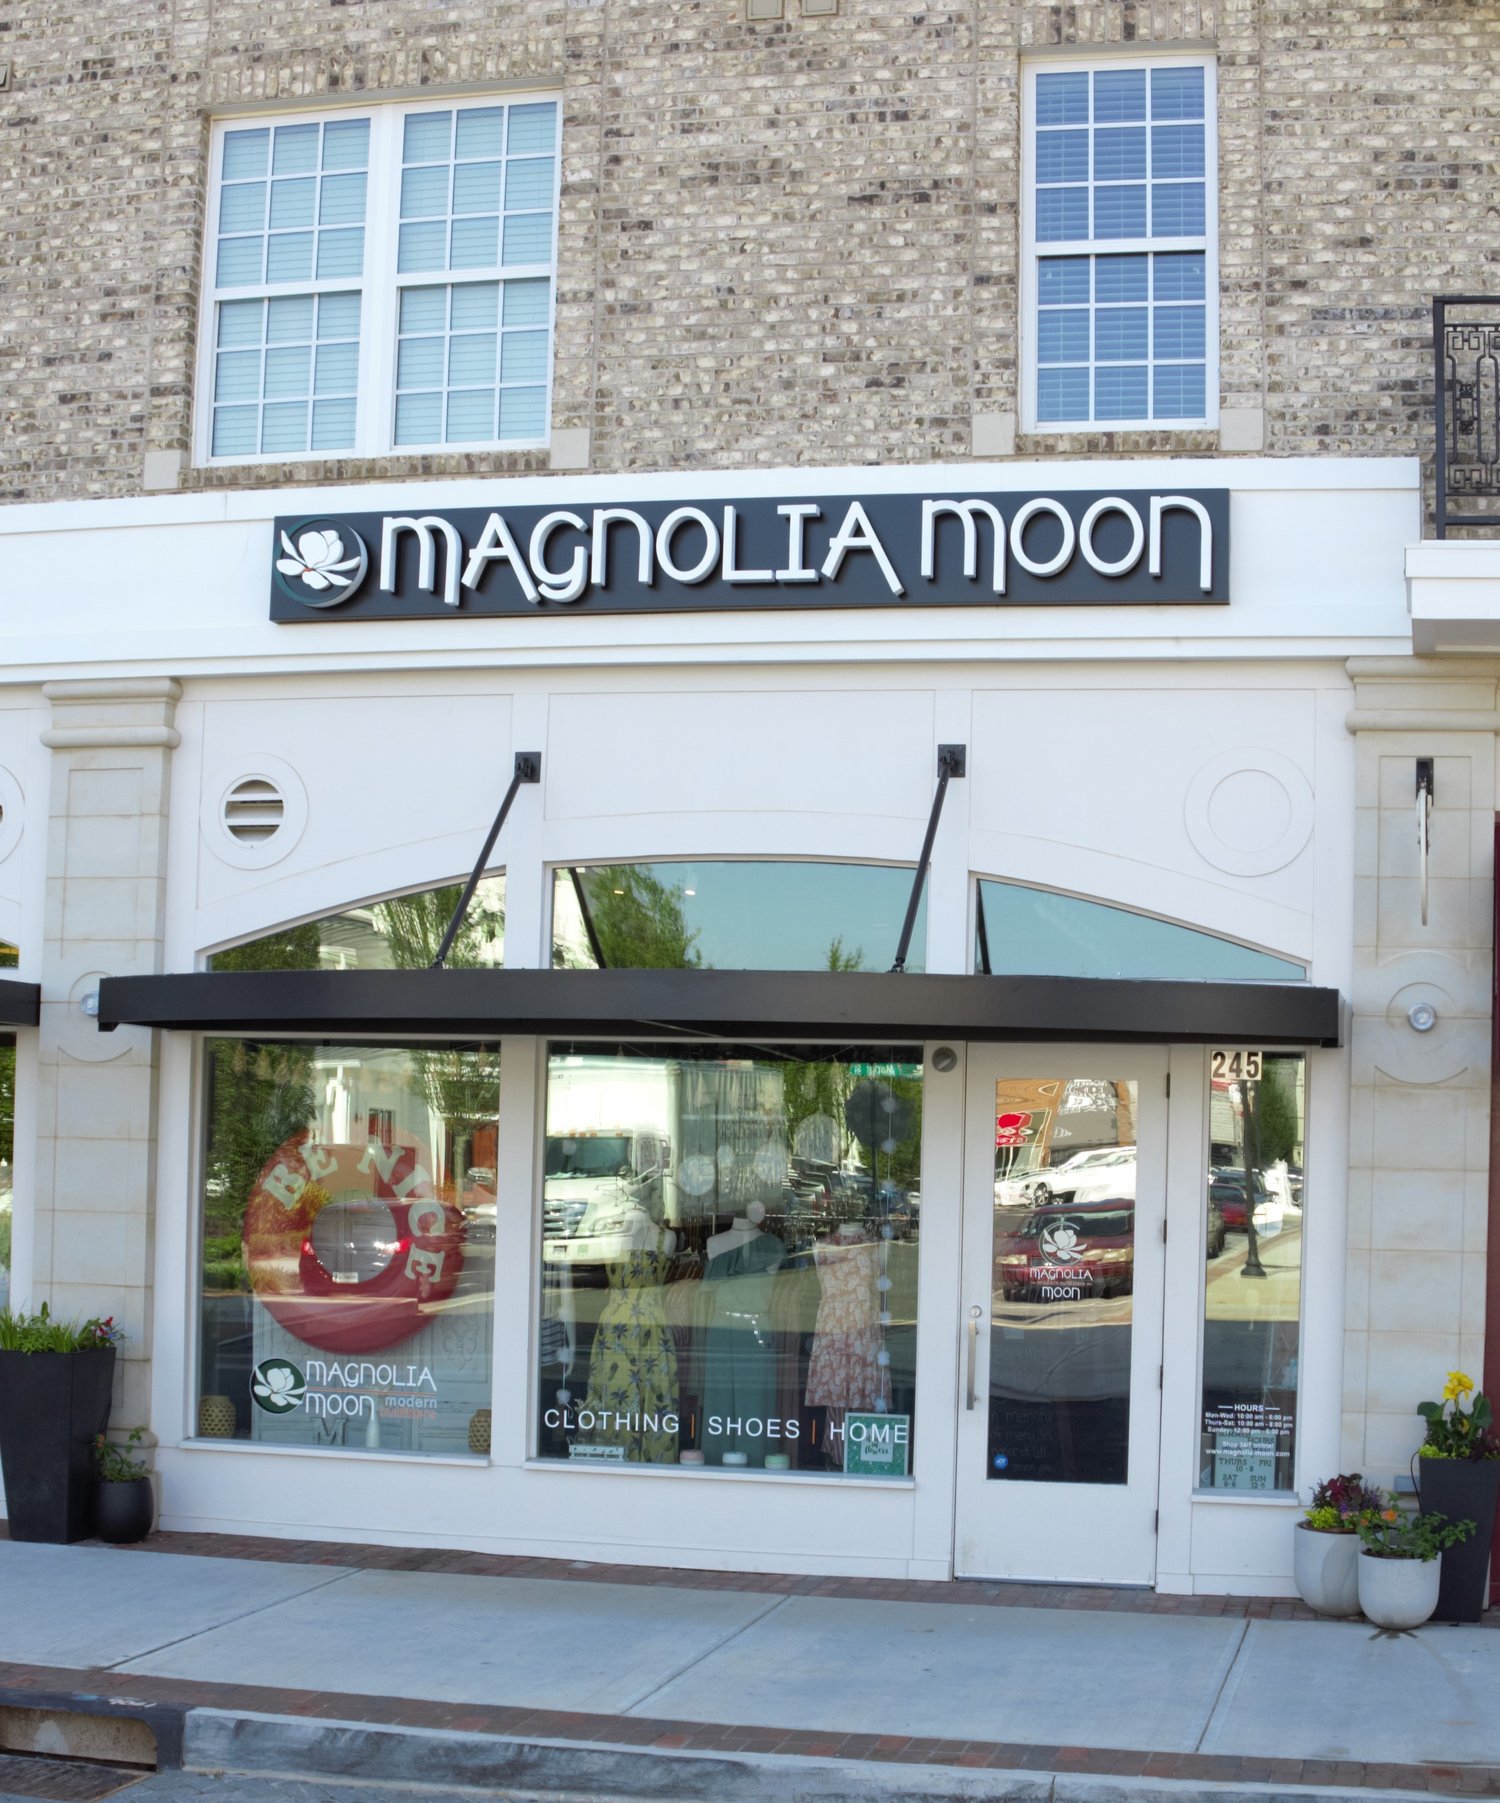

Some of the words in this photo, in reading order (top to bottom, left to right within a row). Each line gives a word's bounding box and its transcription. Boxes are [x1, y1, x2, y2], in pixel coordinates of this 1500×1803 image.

[1212, 1051, 1260, 1079] 245
[262, 1142, 338, 1211] BE
[357, 1136, 446, 1284] NICE
[384, 1395, 438, 1409] modern
[1233, 1404, 1264, 1412] HOURS
[544, 1409, 679, 1433] CLOTHING
[708, 1415, 800, 1439] SHOES
[829, 1422, 908, 1444] HOME
